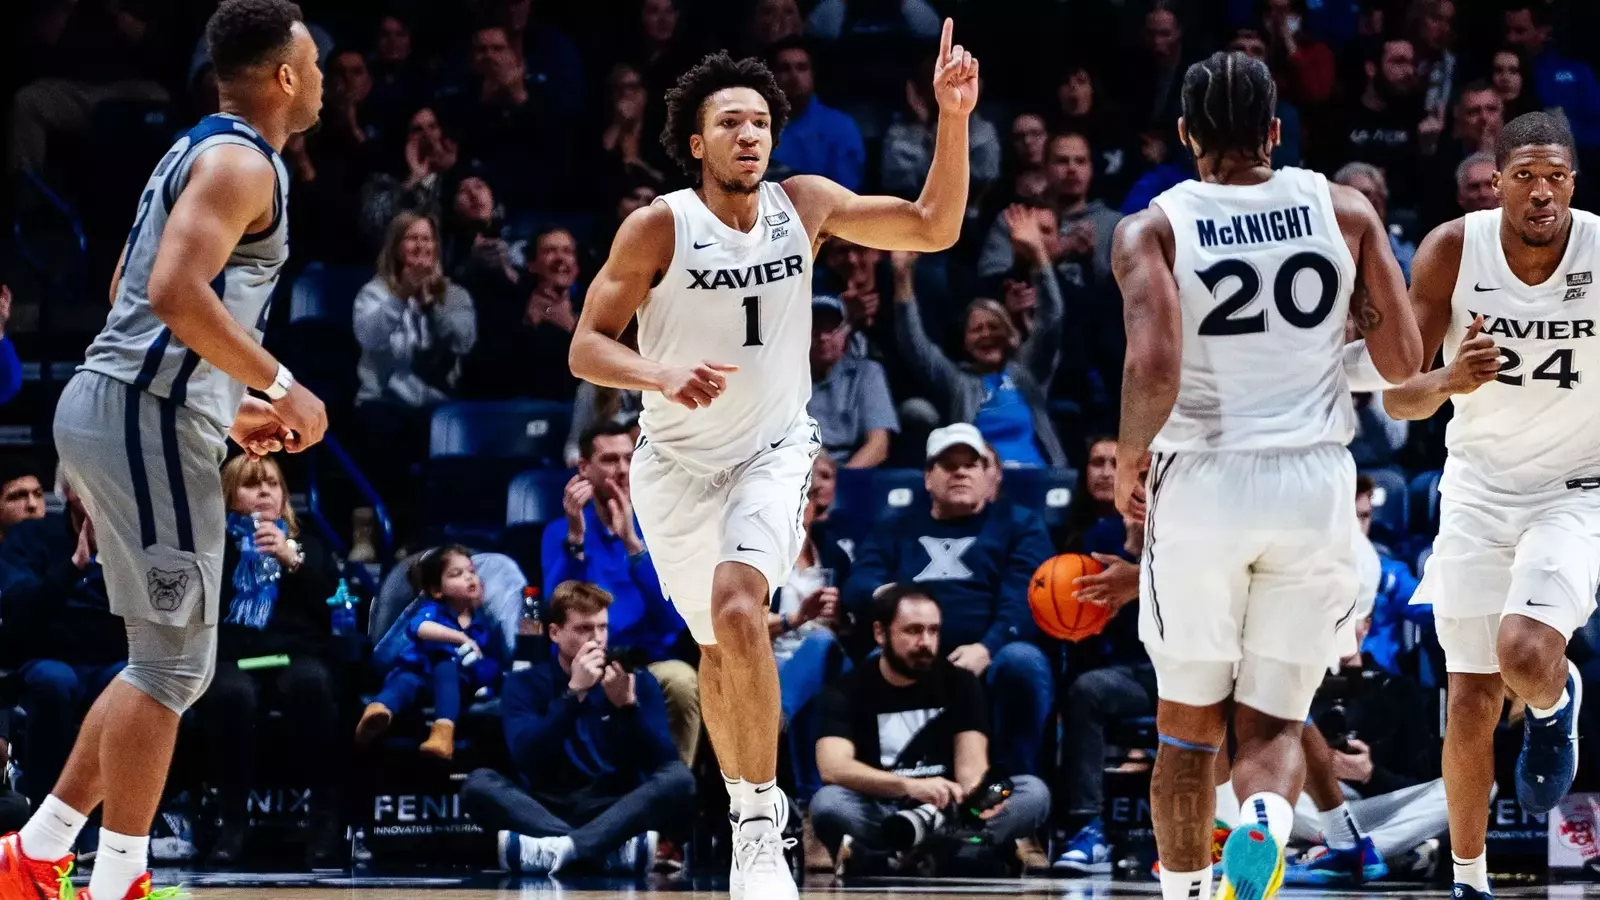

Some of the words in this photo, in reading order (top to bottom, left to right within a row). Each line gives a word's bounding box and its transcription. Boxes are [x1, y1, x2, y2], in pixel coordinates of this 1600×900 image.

[1196, 206, 1313, 247] McKNIGHT
[686, 254, 804, 290] XAVIER
[1194, 251, 1341, 336] 20
[741, 296, 764, 347] 1
[1496, 346, 1581, 390] 24
[246, 788, 312, 813] NIX
[374, 794, 471, 821] FENI
[374, 824, 432, 835] INNOVATIVE
